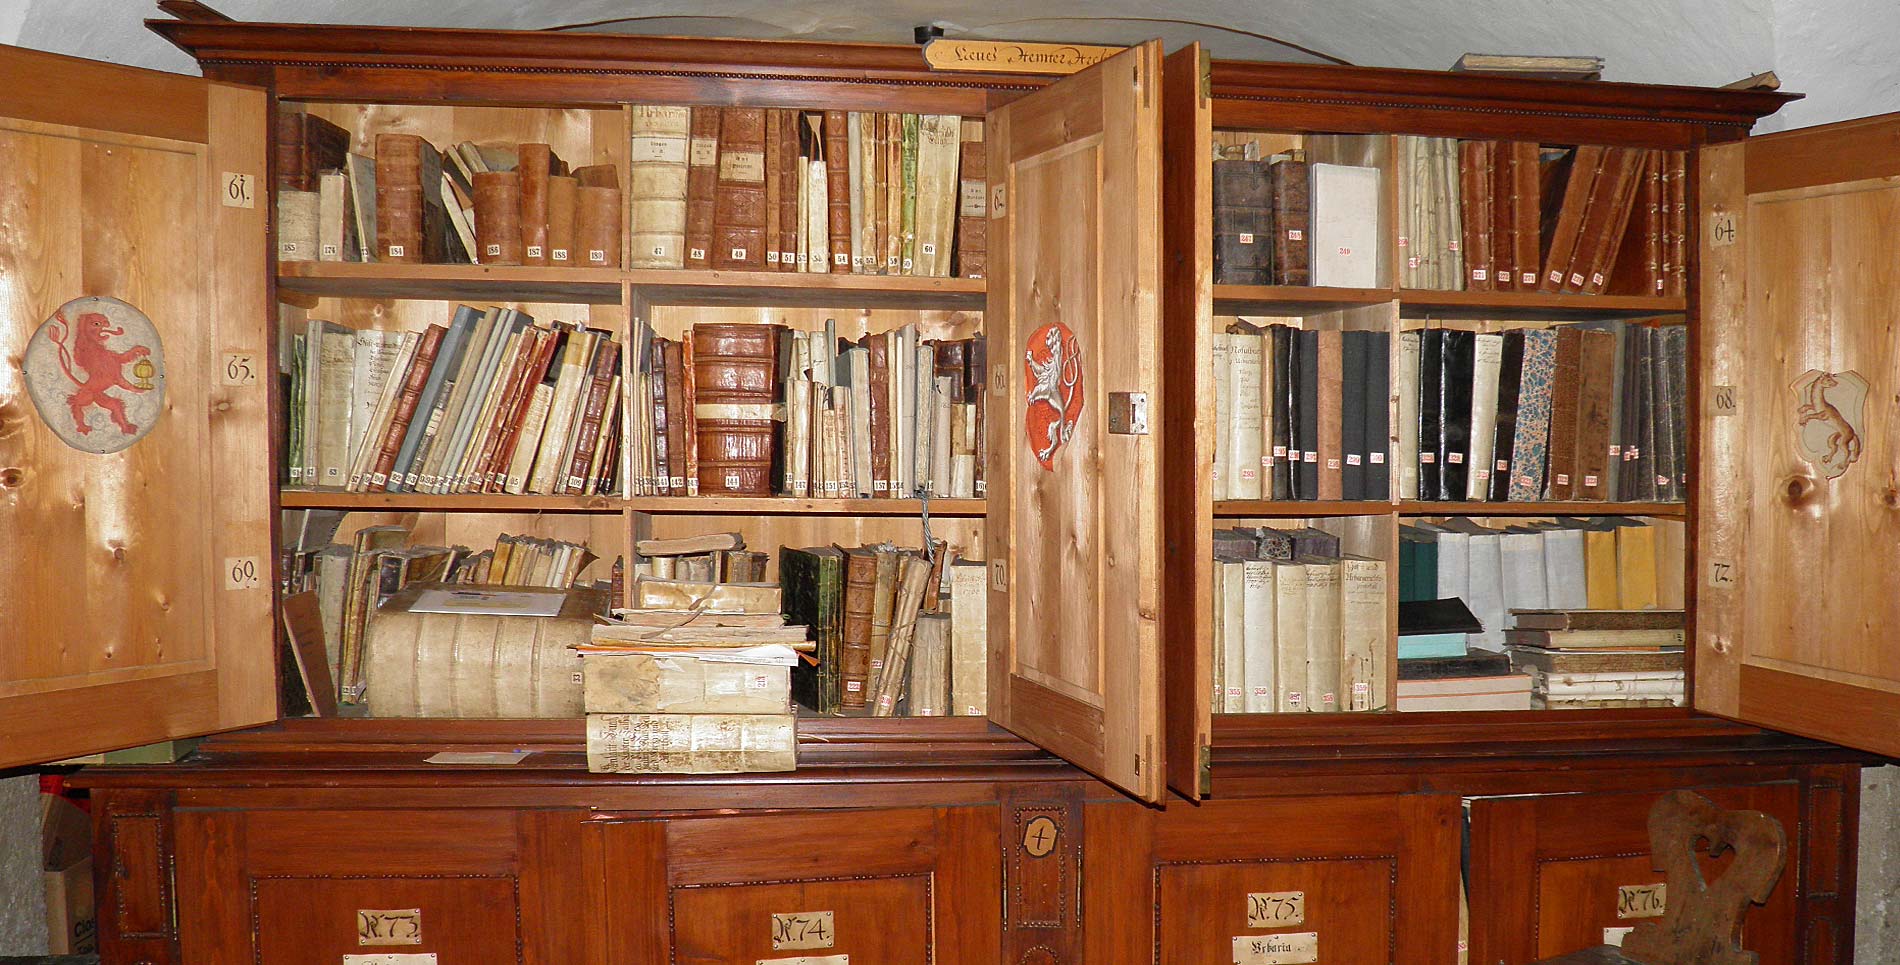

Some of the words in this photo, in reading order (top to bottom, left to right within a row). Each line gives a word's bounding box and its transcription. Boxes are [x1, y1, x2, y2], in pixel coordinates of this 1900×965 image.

[227, 354, 255, 384] 65.
[1716, 388, 1735, 409] 68.
[232, 559, 257, 588] 69.
